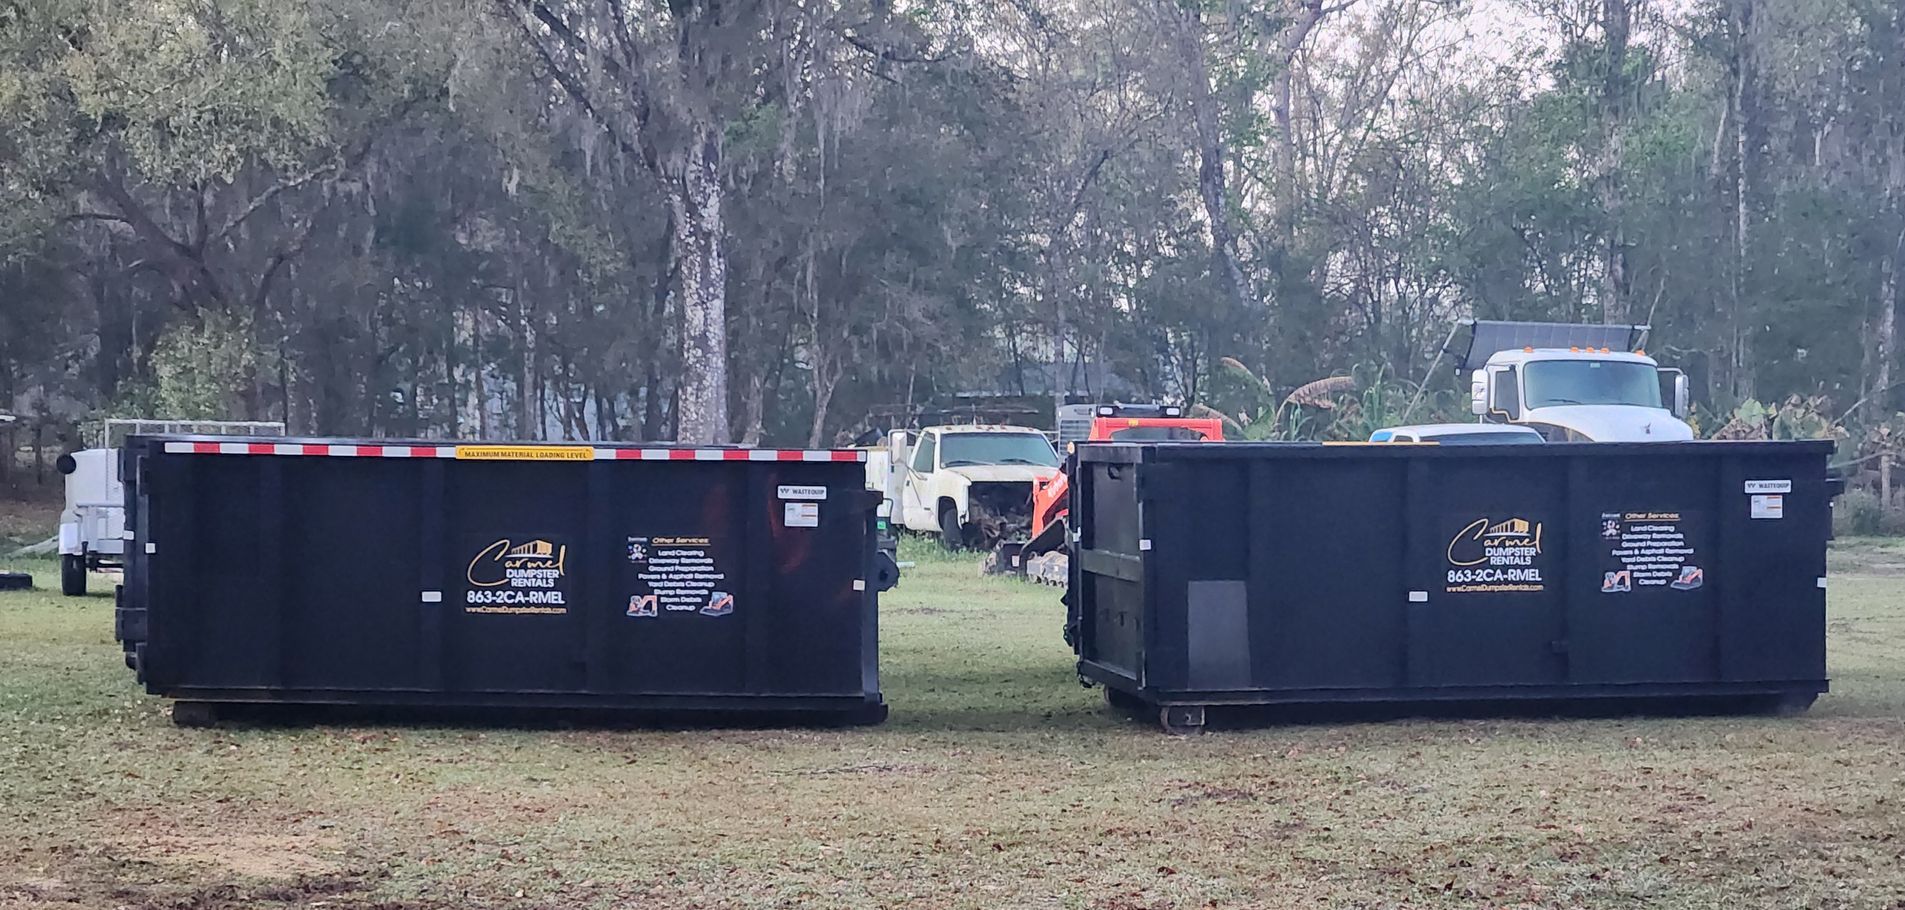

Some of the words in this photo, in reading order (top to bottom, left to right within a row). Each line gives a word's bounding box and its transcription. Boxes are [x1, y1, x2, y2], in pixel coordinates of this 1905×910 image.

[1447, 518, 1542, 566] Carmel
[1485, 547, 1537, 556] DUMPSTER
[467, 539, 566, 586] Carmel
[1490, 556, 1532, 565] RENTALS
[505, 569, 560, 579] DUMPSTER
[1447, 569, 1543, 583] 863-2CA-RMEL
[510, 578, 555, 588] RENTALS
[466, 590, 566, 605] 863-2CA-RMEL
